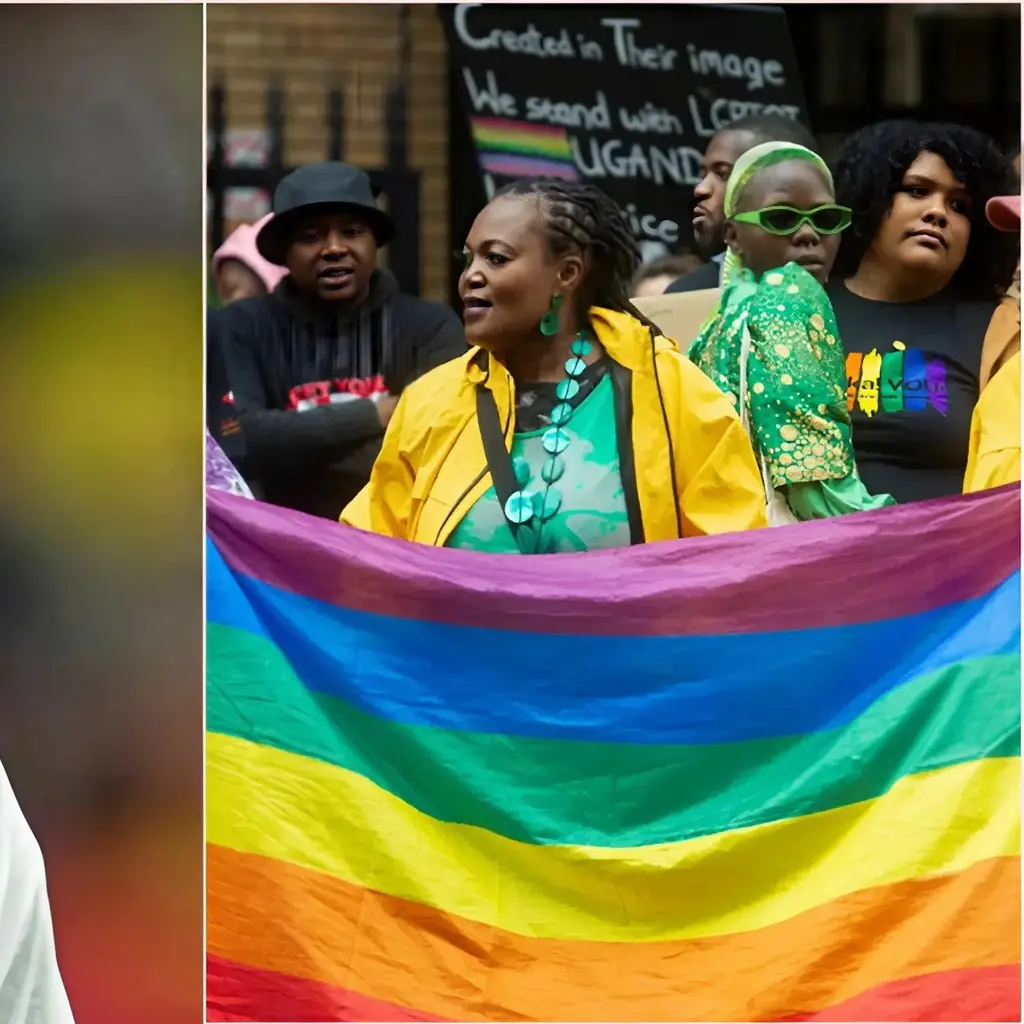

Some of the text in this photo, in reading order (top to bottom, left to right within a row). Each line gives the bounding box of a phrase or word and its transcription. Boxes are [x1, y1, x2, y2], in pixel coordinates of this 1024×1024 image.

[454, 3, 786, 91] Created in Their image
[462, 65, 519, 116] We
[526, 88, 612, 131] stand
[619, 101, 683, 136] with
